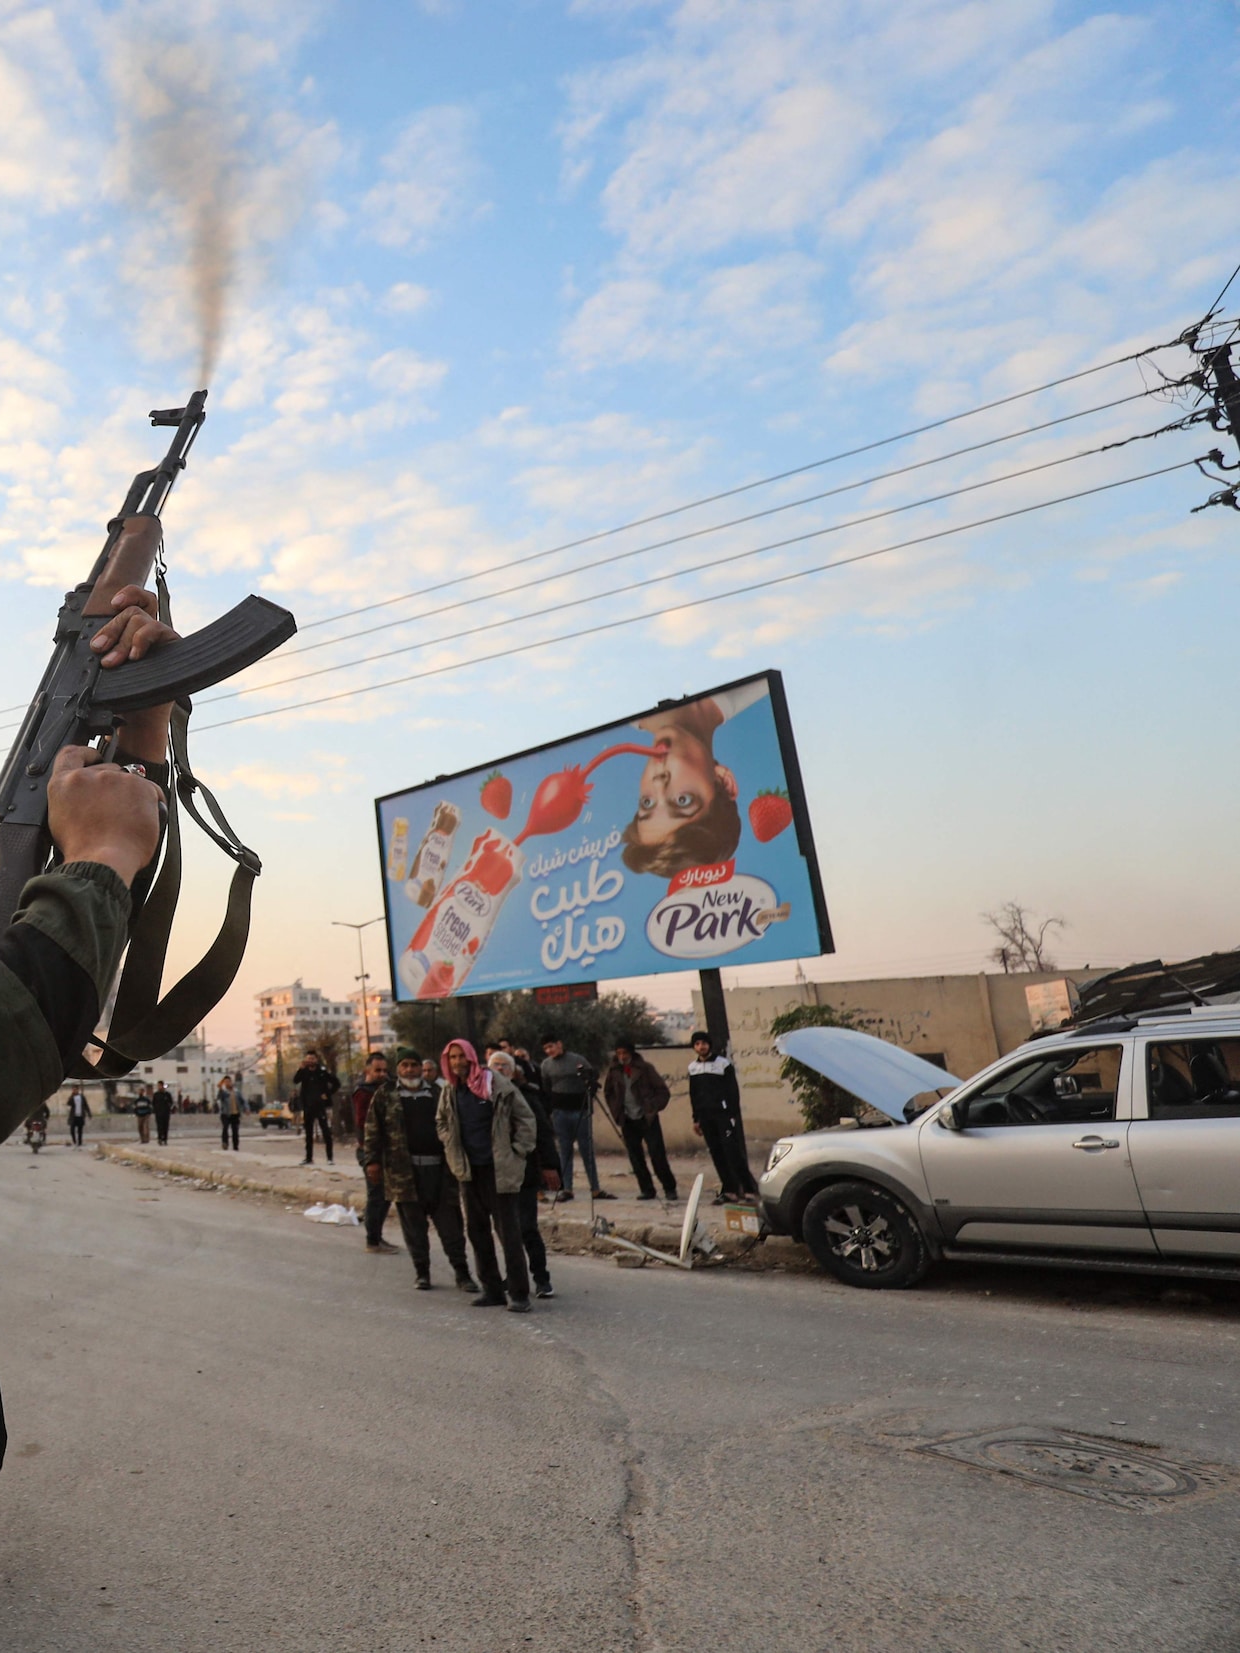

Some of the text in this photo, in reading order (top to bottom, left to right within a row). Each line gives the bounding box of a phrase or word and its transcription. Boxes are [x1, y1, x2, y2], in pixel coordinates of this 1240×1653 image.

[568, 825, 621, 864] فريش
[530, 859, 624, 930] طيب
[678, 865, 727, 886] نيوبارك
[457, 883, 486, 916] Park
[702, 890, 744, 909] New
[441, 905, 471, 943] Fresh
[656, 897, 762, 947] Park
